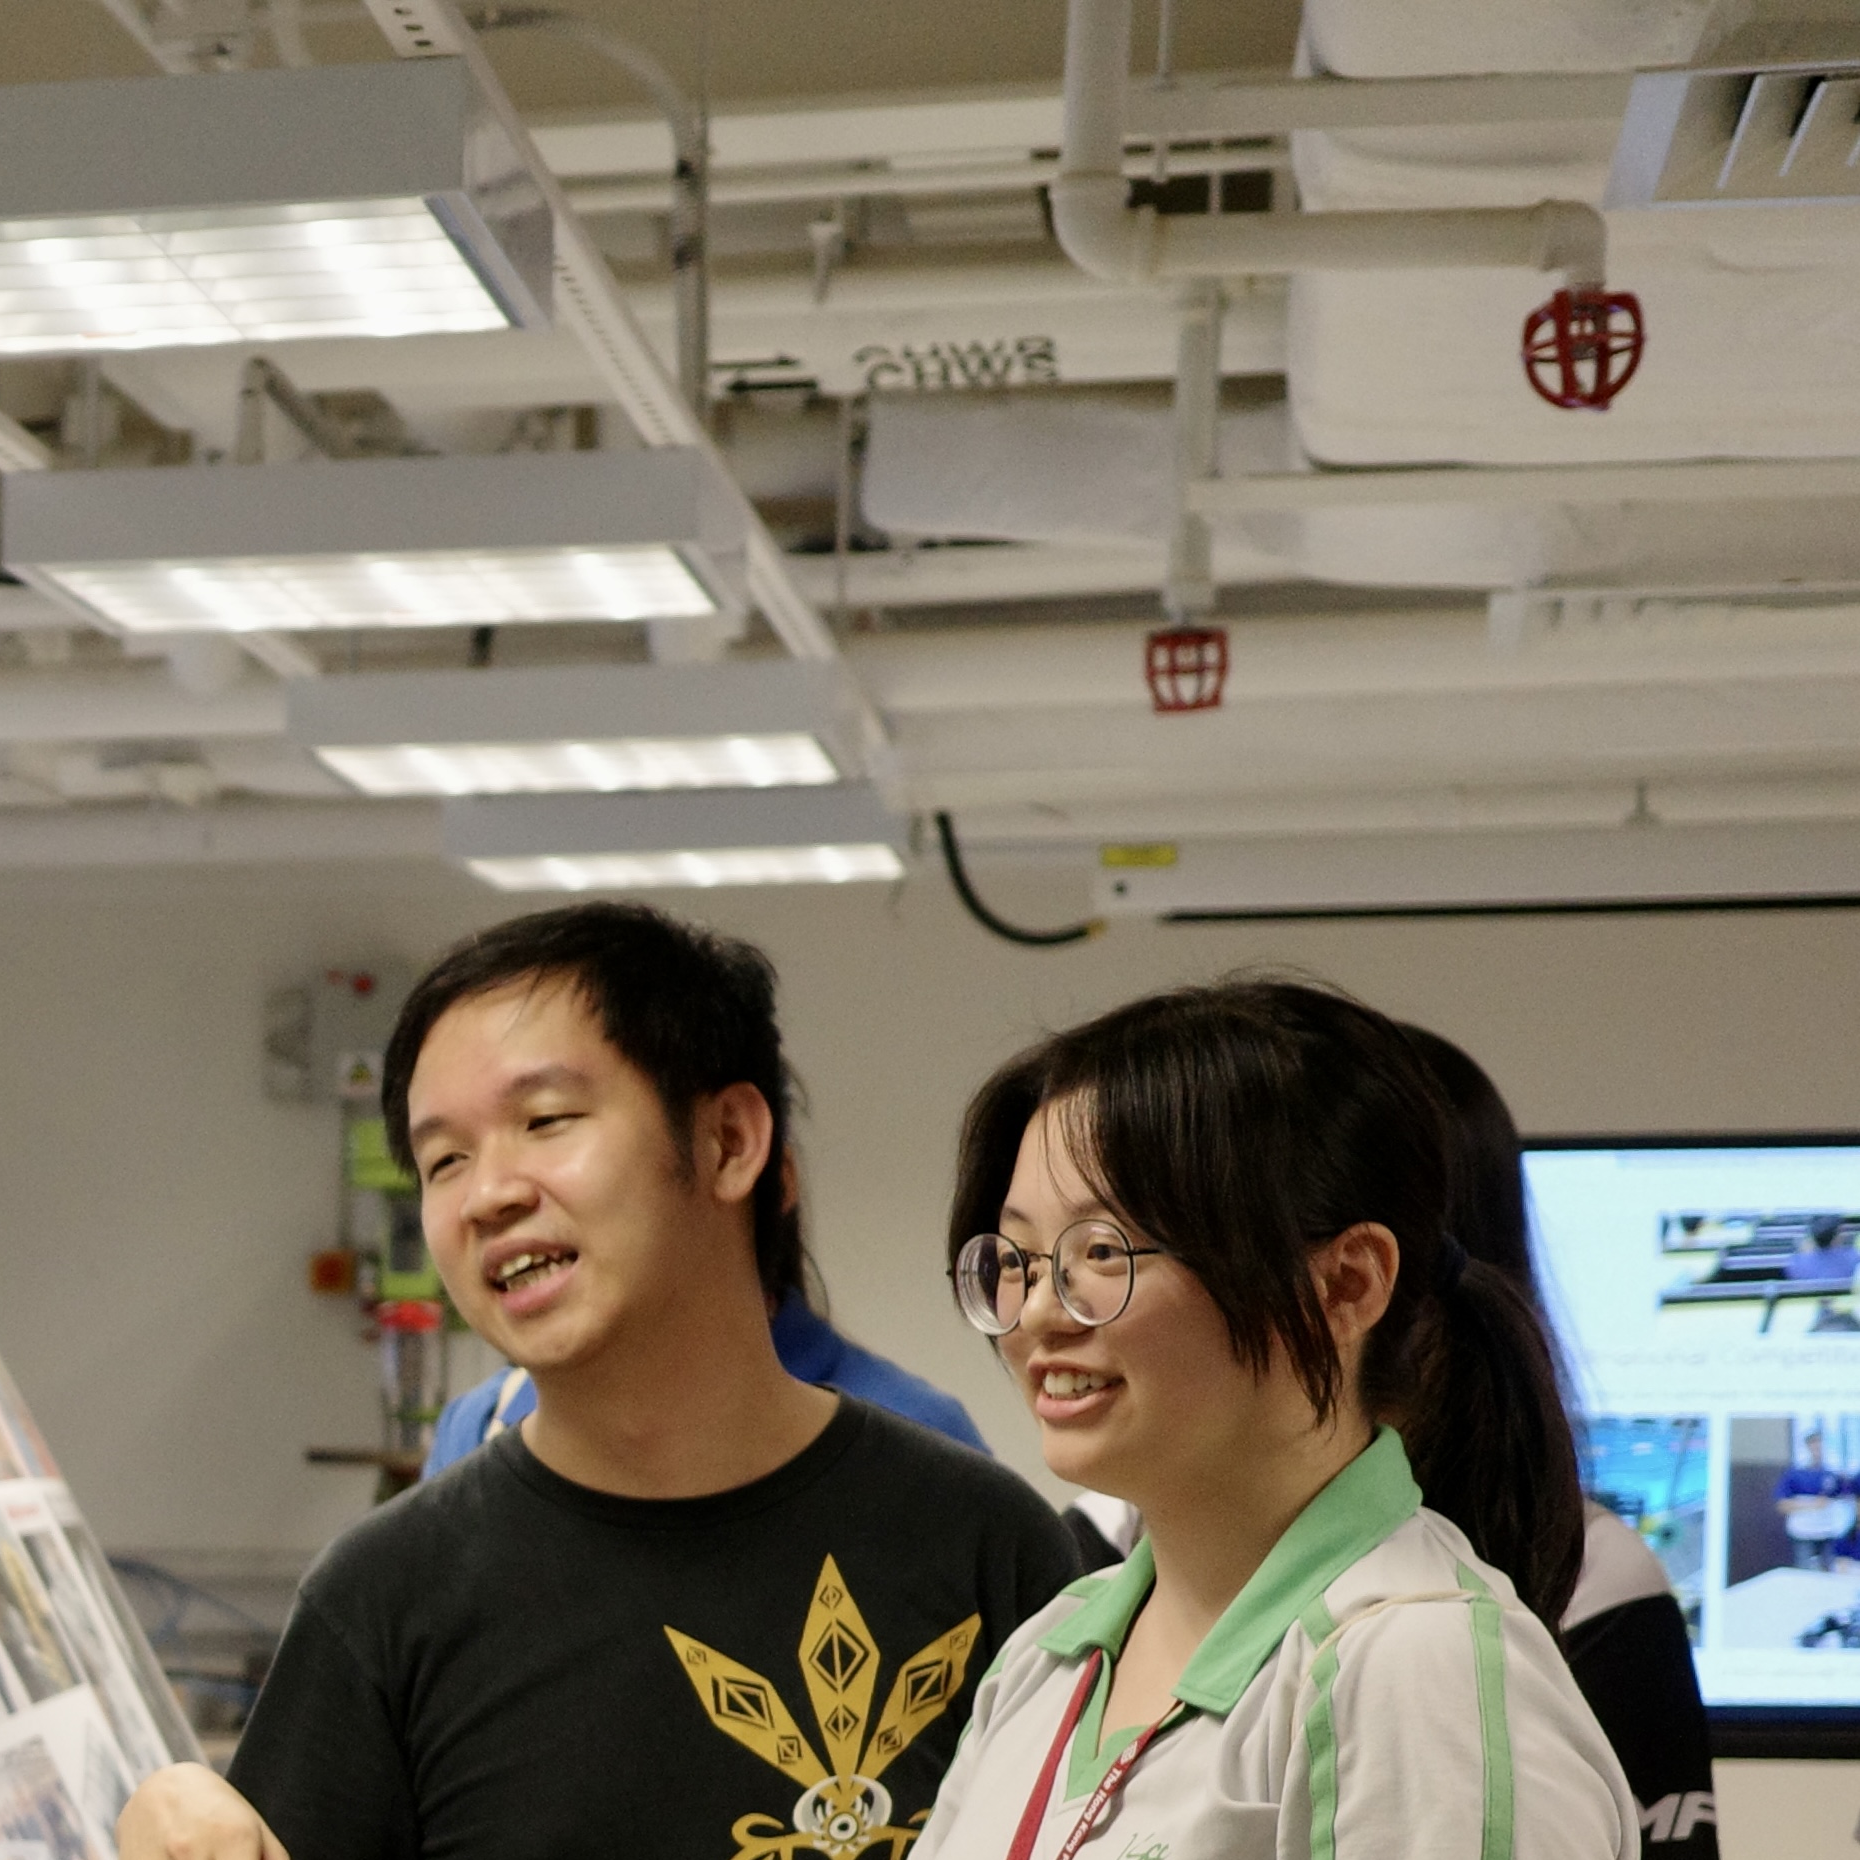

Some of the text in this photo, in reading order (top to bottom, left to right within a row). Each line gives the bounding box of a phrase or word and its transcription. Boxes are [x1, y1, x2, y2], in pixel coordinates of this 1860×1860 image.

[1102, 1767, 1122, 1790] The
[1084, 1789, 1107, 1821] Hong
[1065, 1819, 1088, 1853] Kong
